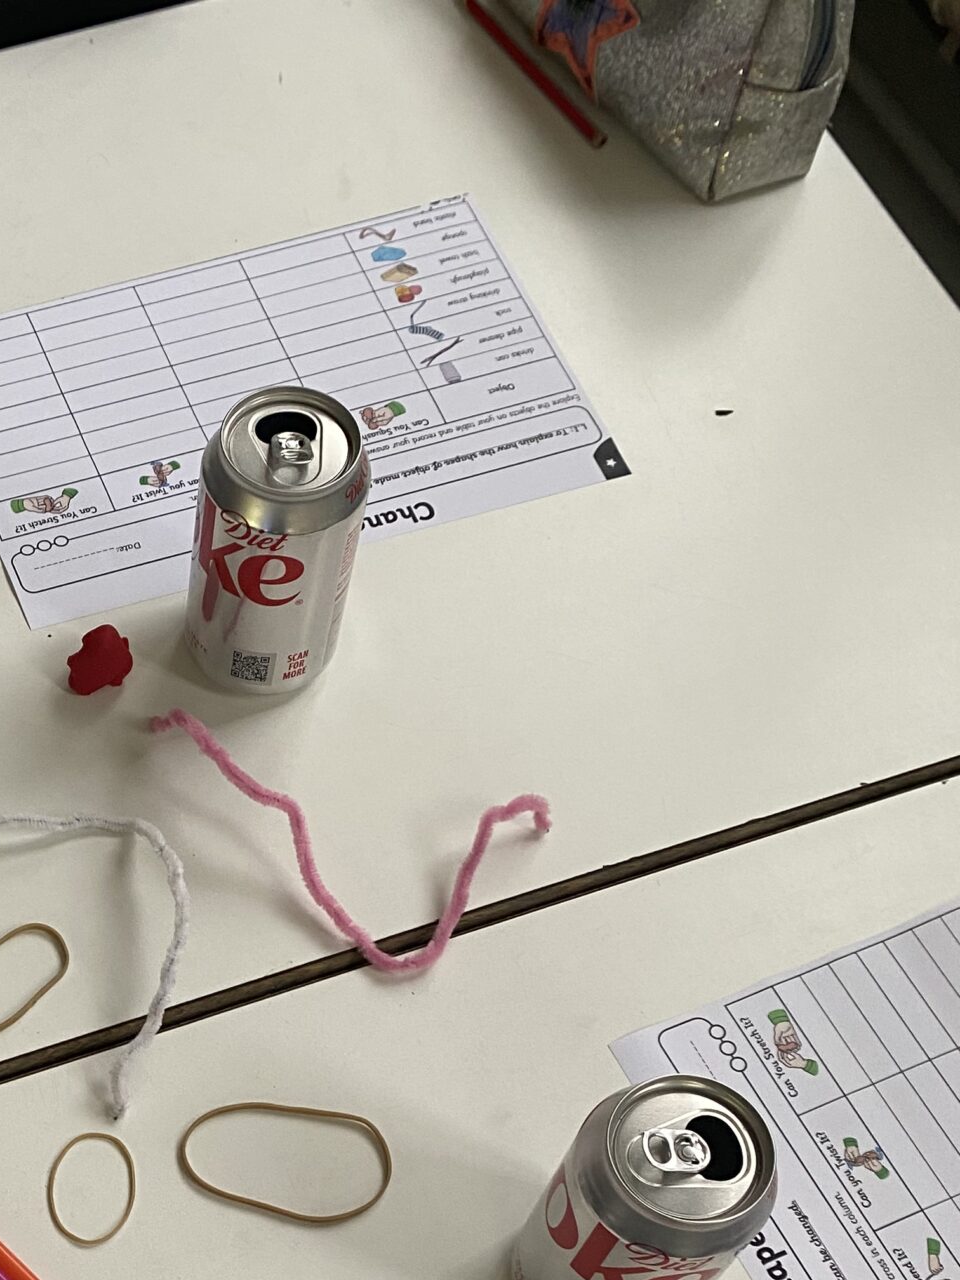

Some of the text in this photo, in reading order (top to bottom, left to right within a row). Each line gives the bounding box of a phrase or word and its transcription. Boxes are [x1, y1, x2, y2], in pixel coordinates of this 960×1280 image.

[487, 382, 516, 395] Object
[361, 418, 431, 443] Can You Squash
[131, 478, 200, 504] an you Twist It?
[14, 505, 98, 534] Can You Stretch It?
[361, 501, 436, 529] Chan
[220, 509, 289, 552] Diet
[198, 491, 305, 607] ke
[287, 649, 310, 664] SCAN
[288, 658, 305, 671] FOR
[282, 665, 308, 681] MORE
[738, 1016, 799, 1099] Can You Stretch It?
[814, 1131, 873, 1209] Can you Twist It?
[854, 1225, 874, 1247] each
[624, 1241, 715, 1272] Diet
[891, 1247, 909, 1263] It?
[876, 1257, 896, 1280] cross
